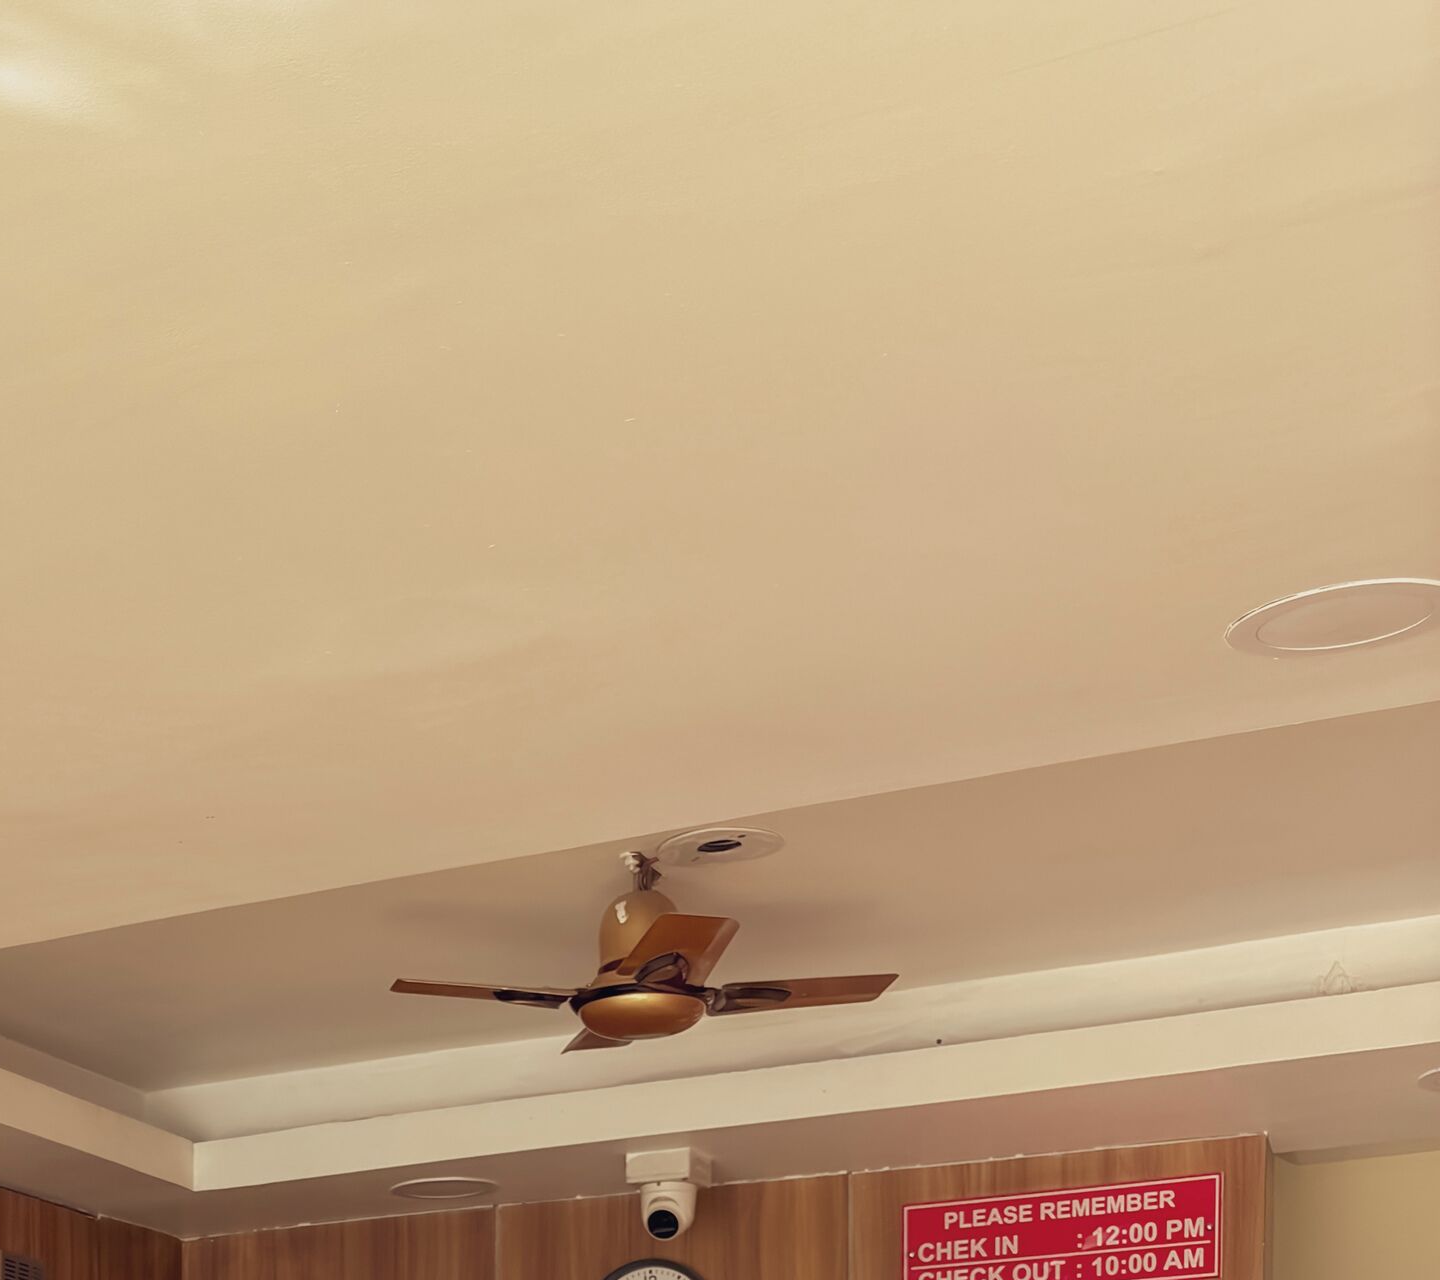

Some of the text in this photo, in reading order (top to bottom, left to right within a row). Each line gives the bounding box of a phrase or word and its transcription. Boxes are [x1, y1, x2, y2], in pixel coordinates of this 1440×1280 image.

[944, 1190, 1176, 1230] PLEASE REMEMBER
[917, 1237, 988, 1263] CHEK
[994, 1235, 1019, 1256] IN
[1092, 1222, 1158, 1247] 12:00
[1166, 1216, 1206, 1240] PM
[1091, 1252, 1158, 1277] 10:00
[1163, 1247, 1205, 1271] AM
